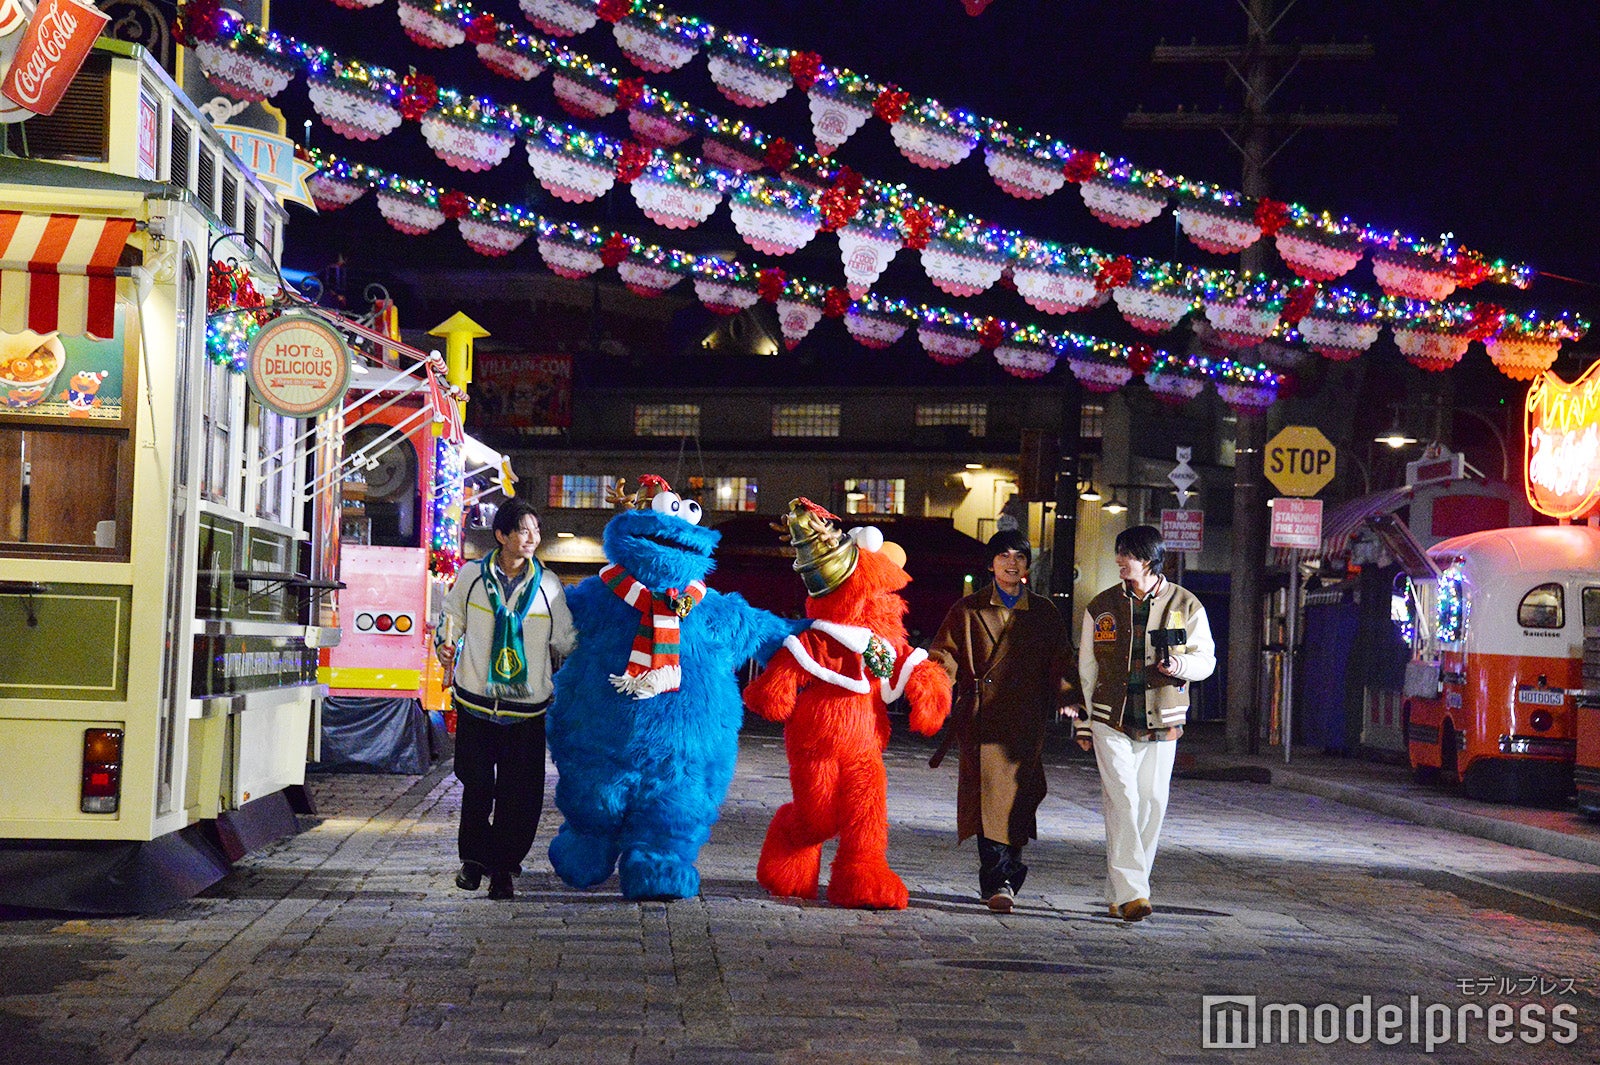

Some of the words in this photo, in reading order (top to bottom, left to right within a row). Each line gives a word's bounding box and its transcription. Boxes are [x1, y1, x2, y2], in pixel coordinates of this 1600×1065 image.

[219, 133, 282, 174] ETY
[855, 254, 875, 265] FOOD
[848, 260, 877, 273] FESTIVAL
[276, 344, 311, 357] HOT
[312, 347, 323, 358] &
[265, 357, 332, 377] DELICIOUS
[1179, 452, 1188, 460] NO
[1270, 448, 1331, 475] STOP
[1170, 472, 1195, 480] PARKING
[1290, 501, 1304, 513] NO
[1176, 512, 1189, 521] NO
[1275, 512, 1319, 523] STANDING
[1164, 521, 1200, 530] STANDING
[1275, 523, 1293, 533] FIRE
[1295, 524, 1317, 534] ZONE
[1164, 530, 1179, 539] FIRE
[1180, 531, 1199, 540] ZONE
[1522, 629, 1560, 638] Saucisse
[1521, 692, 1561, 704] HOTDOGS
